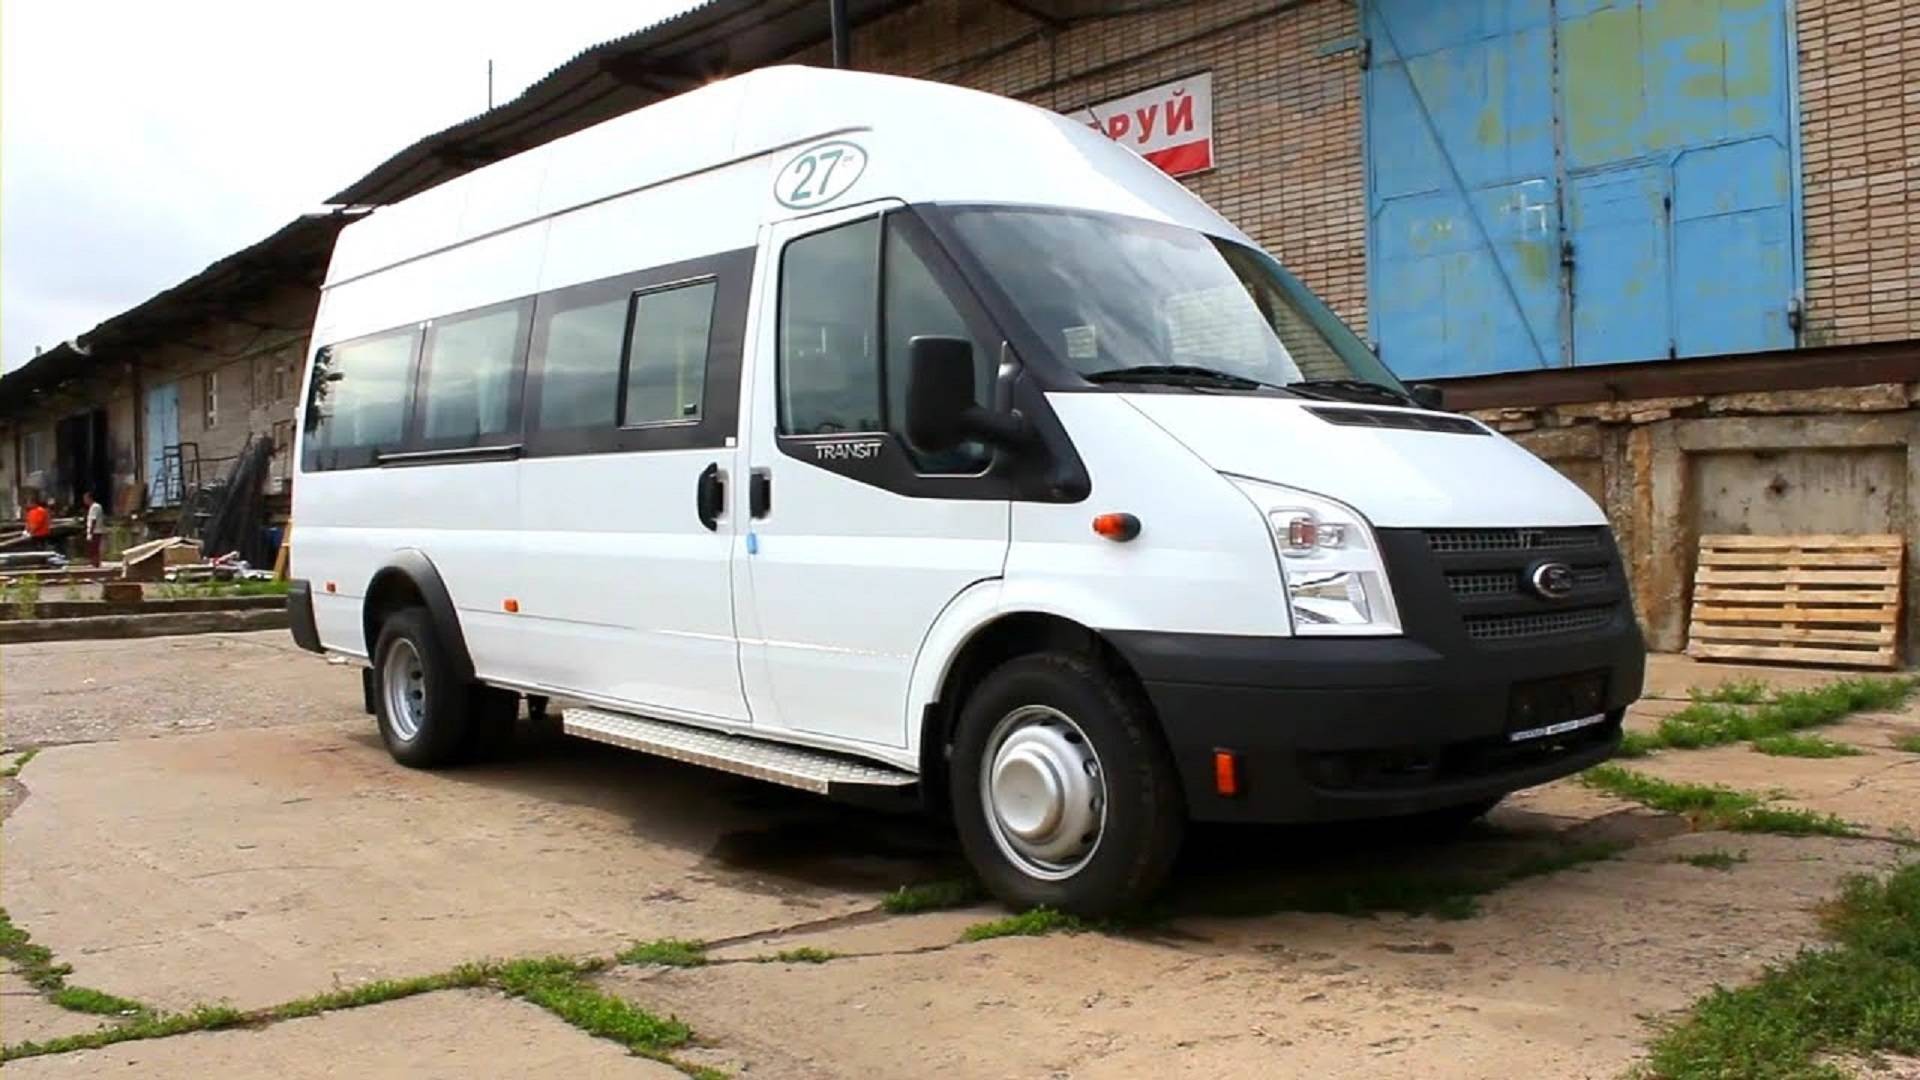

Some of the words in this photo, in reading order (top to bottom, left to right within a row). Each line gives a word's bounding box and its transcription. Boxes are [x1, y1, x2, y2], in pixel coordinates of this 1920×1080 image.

[1088, 88, 1194, 143] РУЙ
[791, 150, 843, 200] 27
[816, 443, 882, 459] TRANSIT
